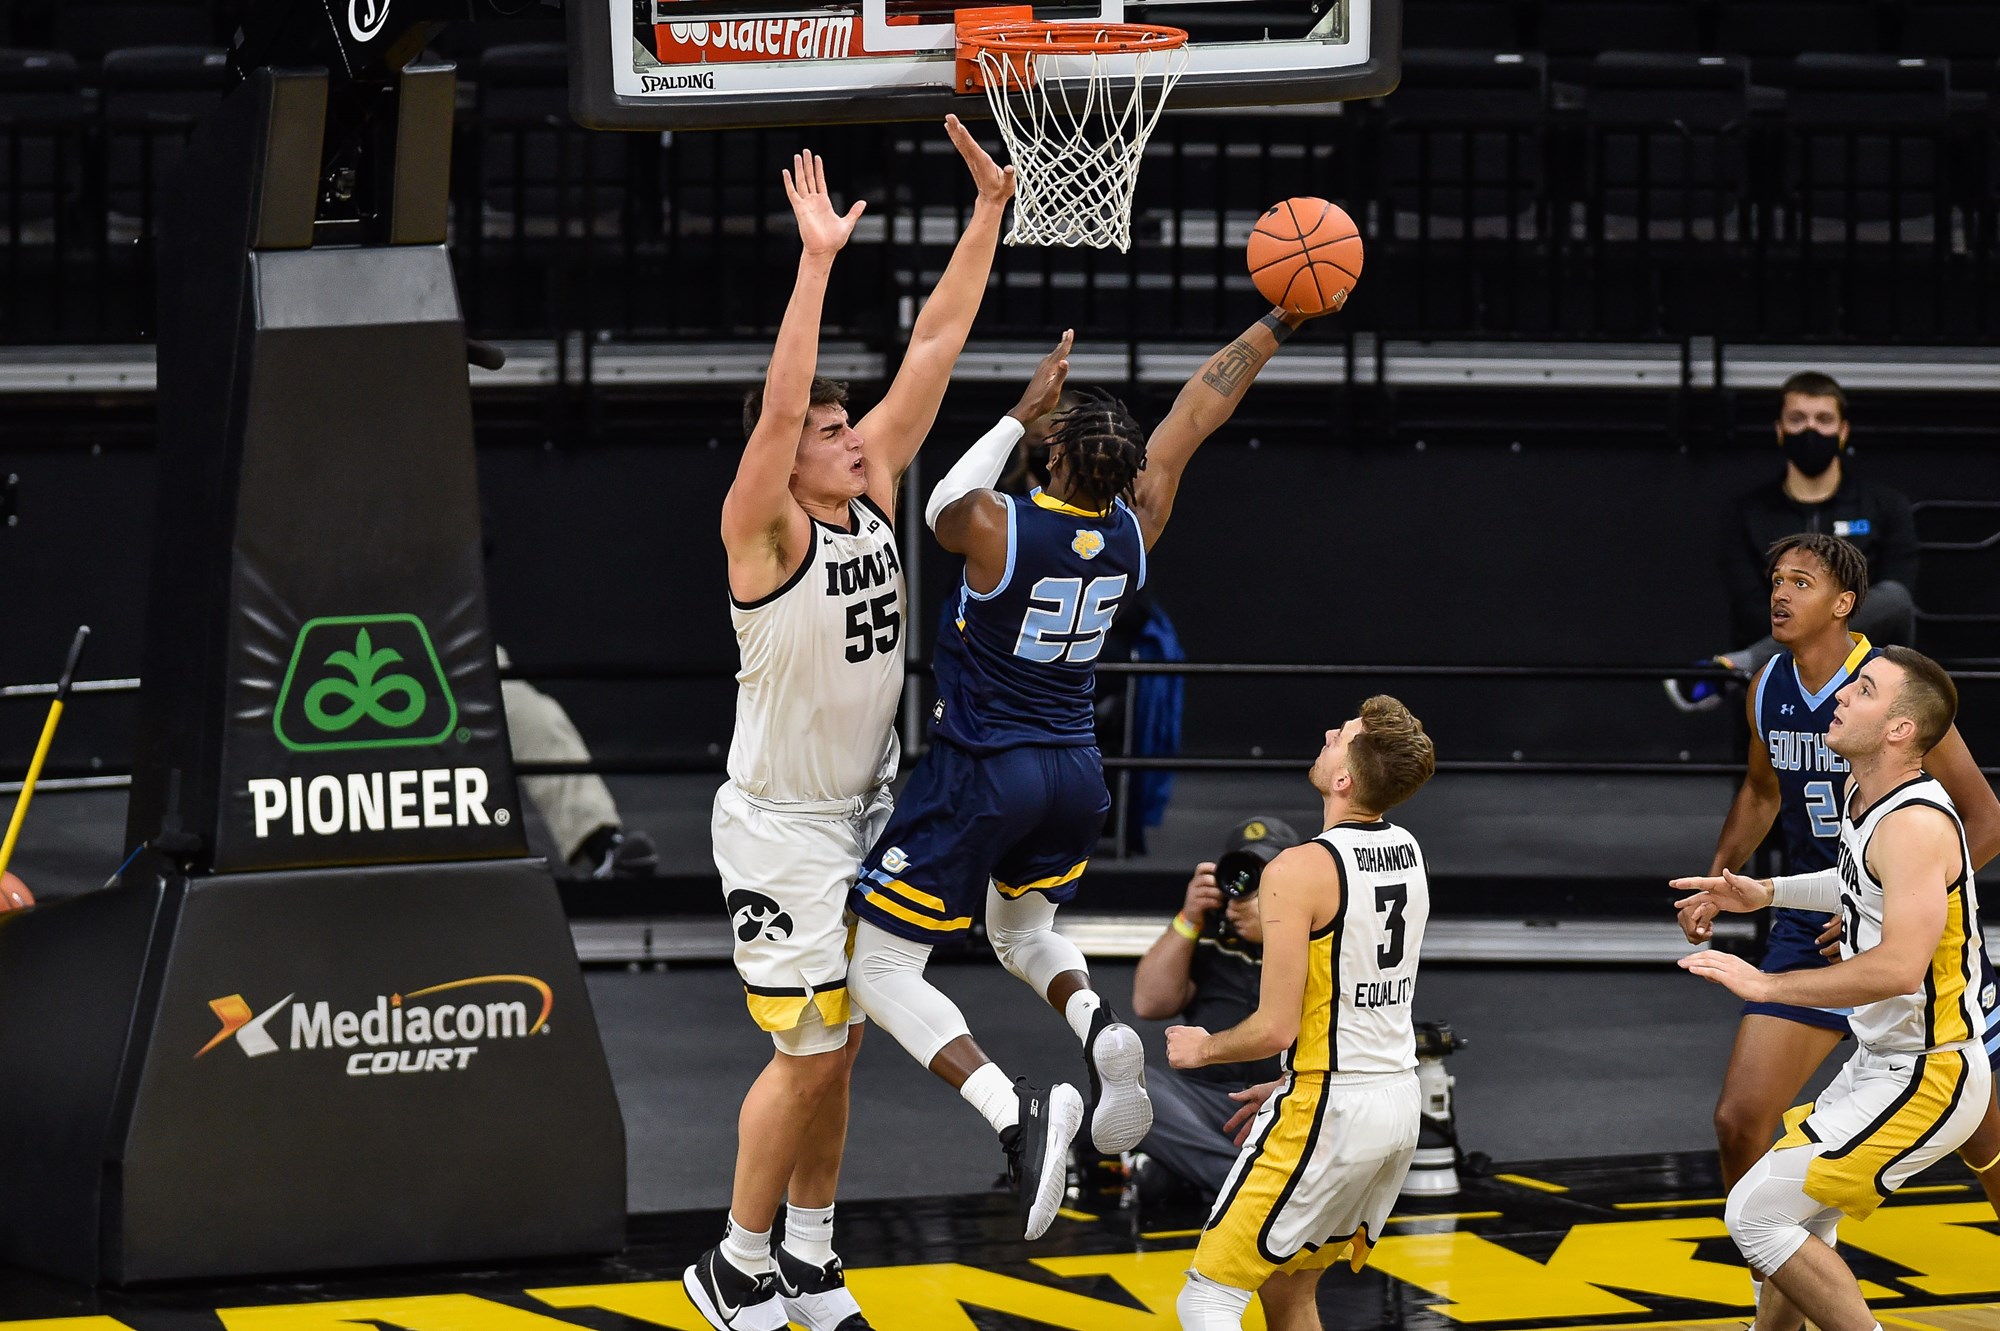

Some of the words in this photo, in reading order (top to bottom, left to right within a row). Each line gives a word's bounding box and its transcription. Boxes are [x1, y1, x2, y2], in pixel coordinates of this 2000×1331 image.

[641, 71, 714, 93] SPALDING
[825, 541, 899, 596] IOWA
[845, 589, 900, 664] 55
[1013, 573, 1128, 664] 25
[1768, 730, 1851, 773] SOUTHE
[248, 767, 490, 838] PIONEER
[1804, 781, 1841, 838] 2
[1353, 843, 1418, 873] BOHANNON
[1374, 883, 1408, 971] 3
[290, 995, 528, 1050] Mediacom
[346, 1046, 479, 1076] COURT
